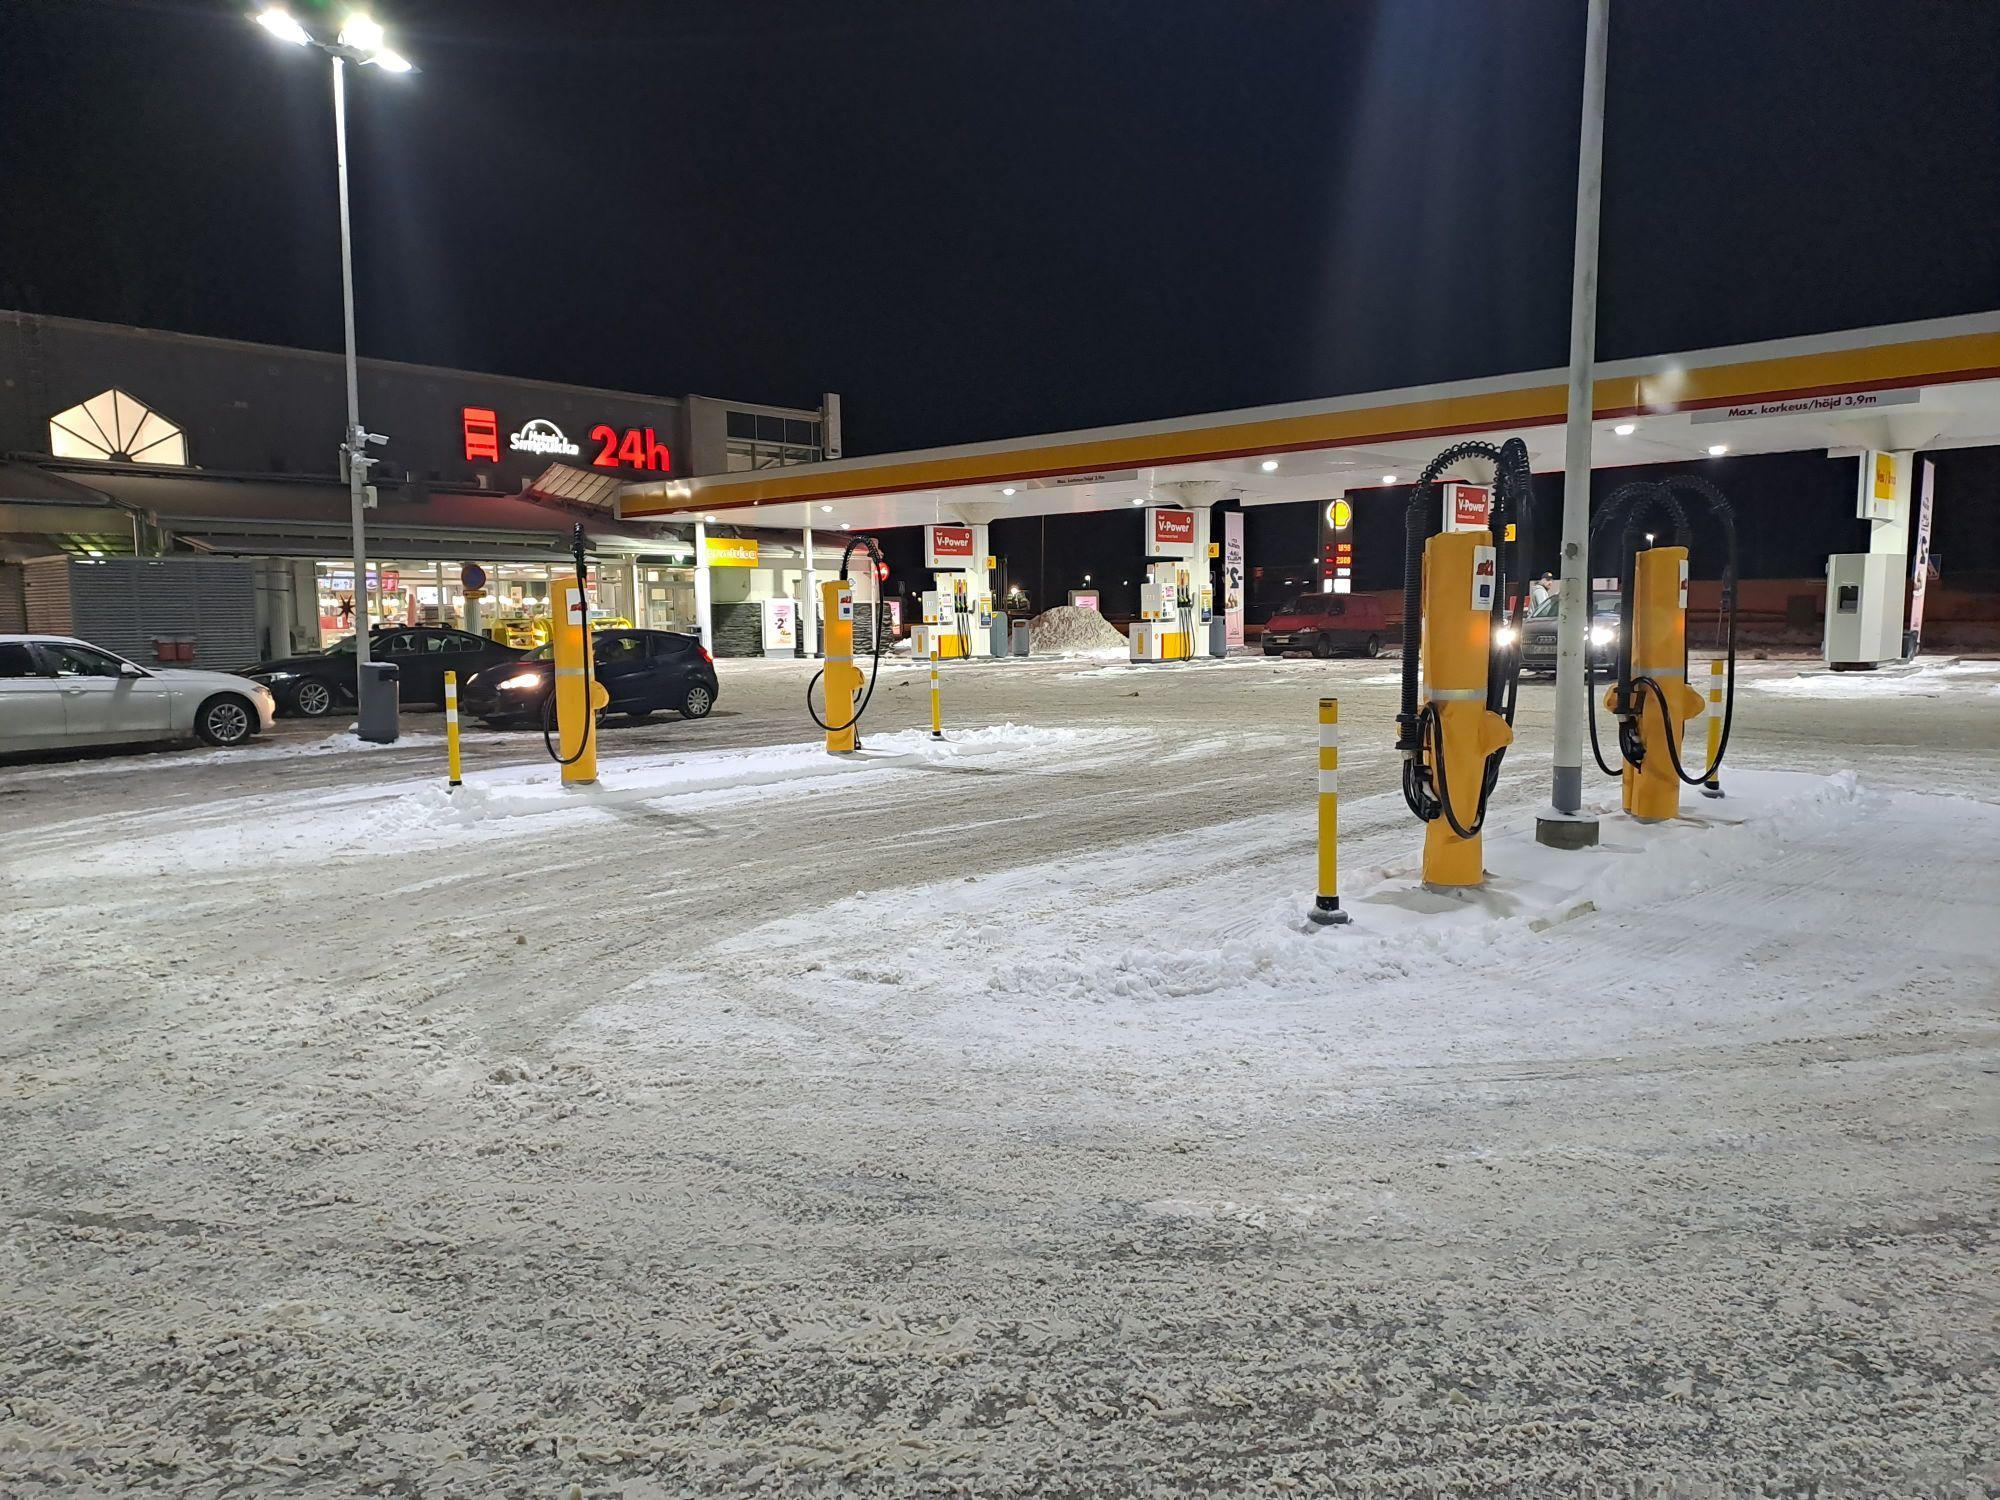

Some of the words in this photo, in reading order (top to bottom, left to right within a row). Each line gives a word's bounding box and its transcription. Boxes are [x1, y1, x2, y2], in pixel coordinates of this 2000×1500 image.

[1728, 408, 1757, 417] Max.
[1760, 398, 1842, 414] korkeus/höjd
[1845, 395, 1877, 407] 3,9m
[591, 425, 671, 471] 24h
[1158, 520, 1190, 533] V-Power
[936, 536, 969, 547] V-Power
